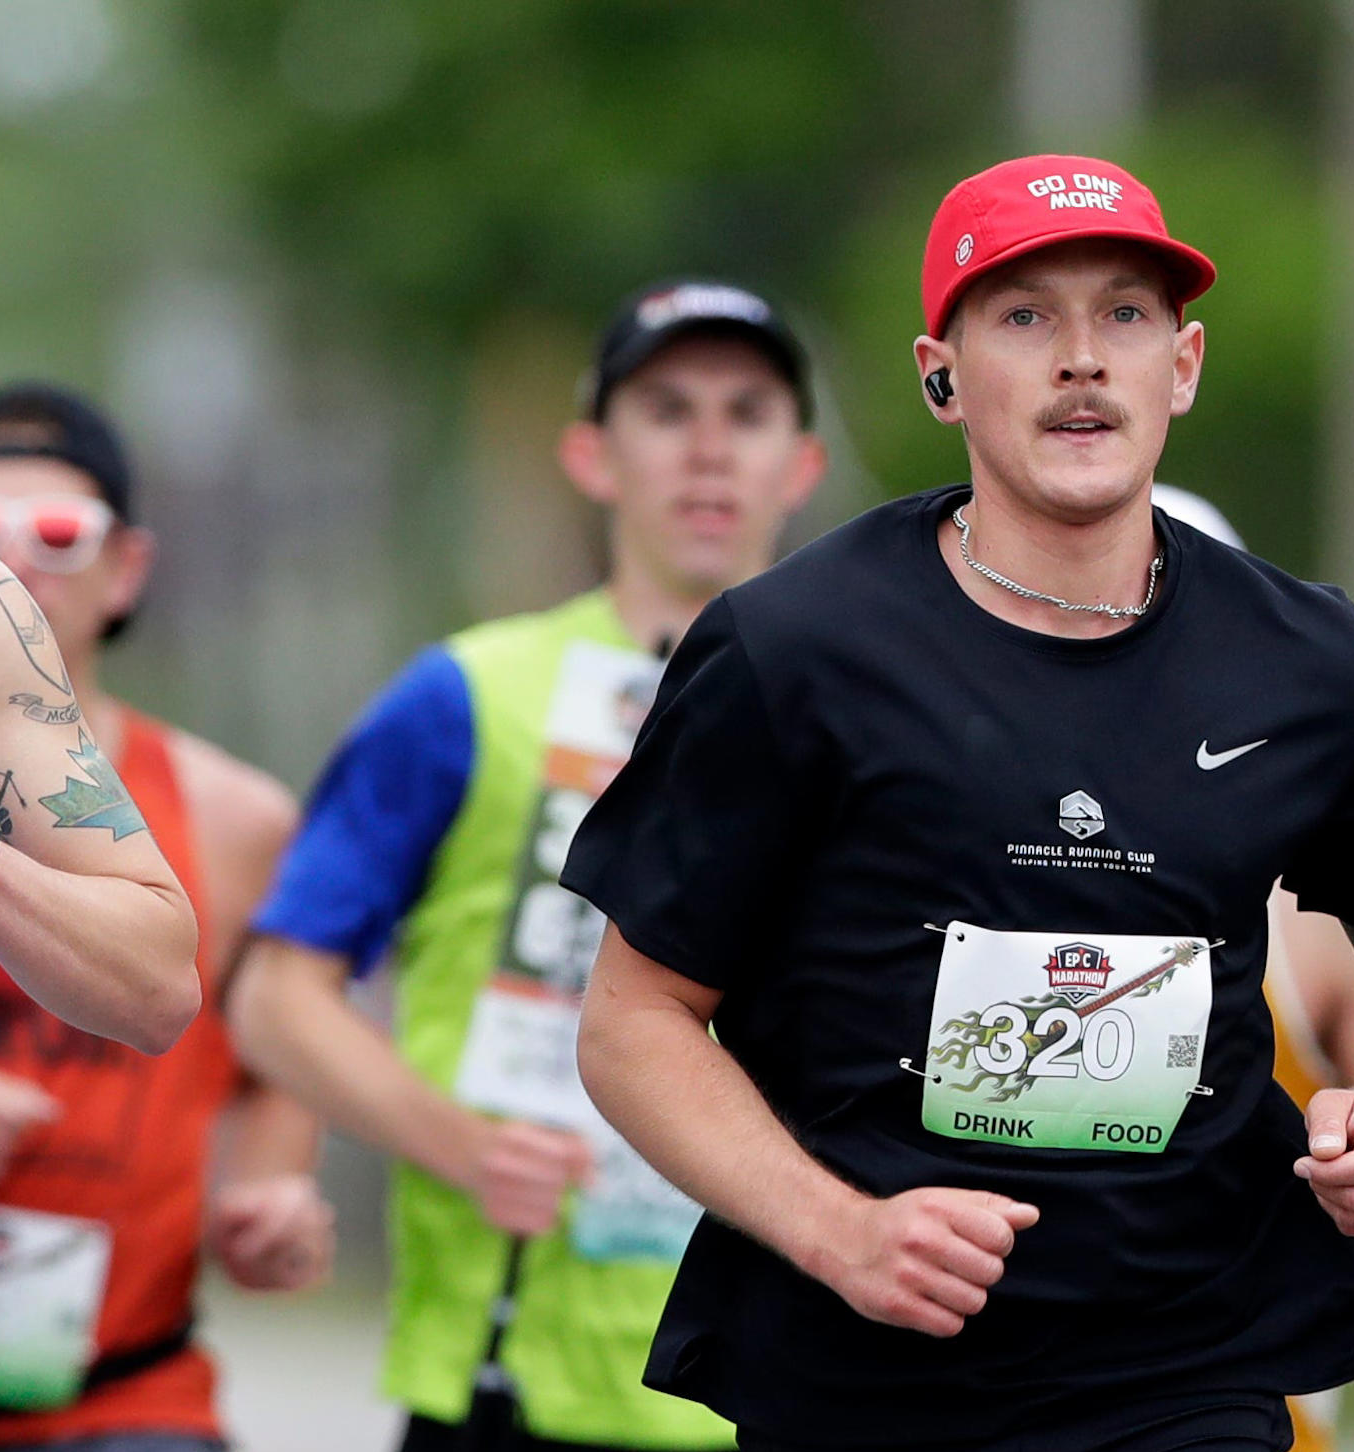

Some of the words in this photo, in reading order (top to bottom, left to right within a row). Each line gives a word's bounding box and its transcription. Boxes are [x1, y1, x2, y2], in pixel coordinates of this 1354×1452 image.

[1027, 175, 1067, 198] GO
[1072, 173, 1123, 200] ONE
[1050, 191, 1118, 213] MORE
[1007, 843, 1063, 857] PINNACLE
[1068, 846, 1122, 860] RUNNING
[1127, 851, 1156, 864] CLUB
[1011, 858, 1048, 867] HELPING
[1051, 860, 1068, 868] YOU
[1071, 860, 1099, 869] REACH
[1103, 862, 1126, 871] YOUR
[1052, 970, 1106, 986] MARATHON
[973, 1002, 1135, 1081] 320
[953, 1111, 1035, 1139] DRINK
[1092, 1122, 1163, 1145] FOOD
